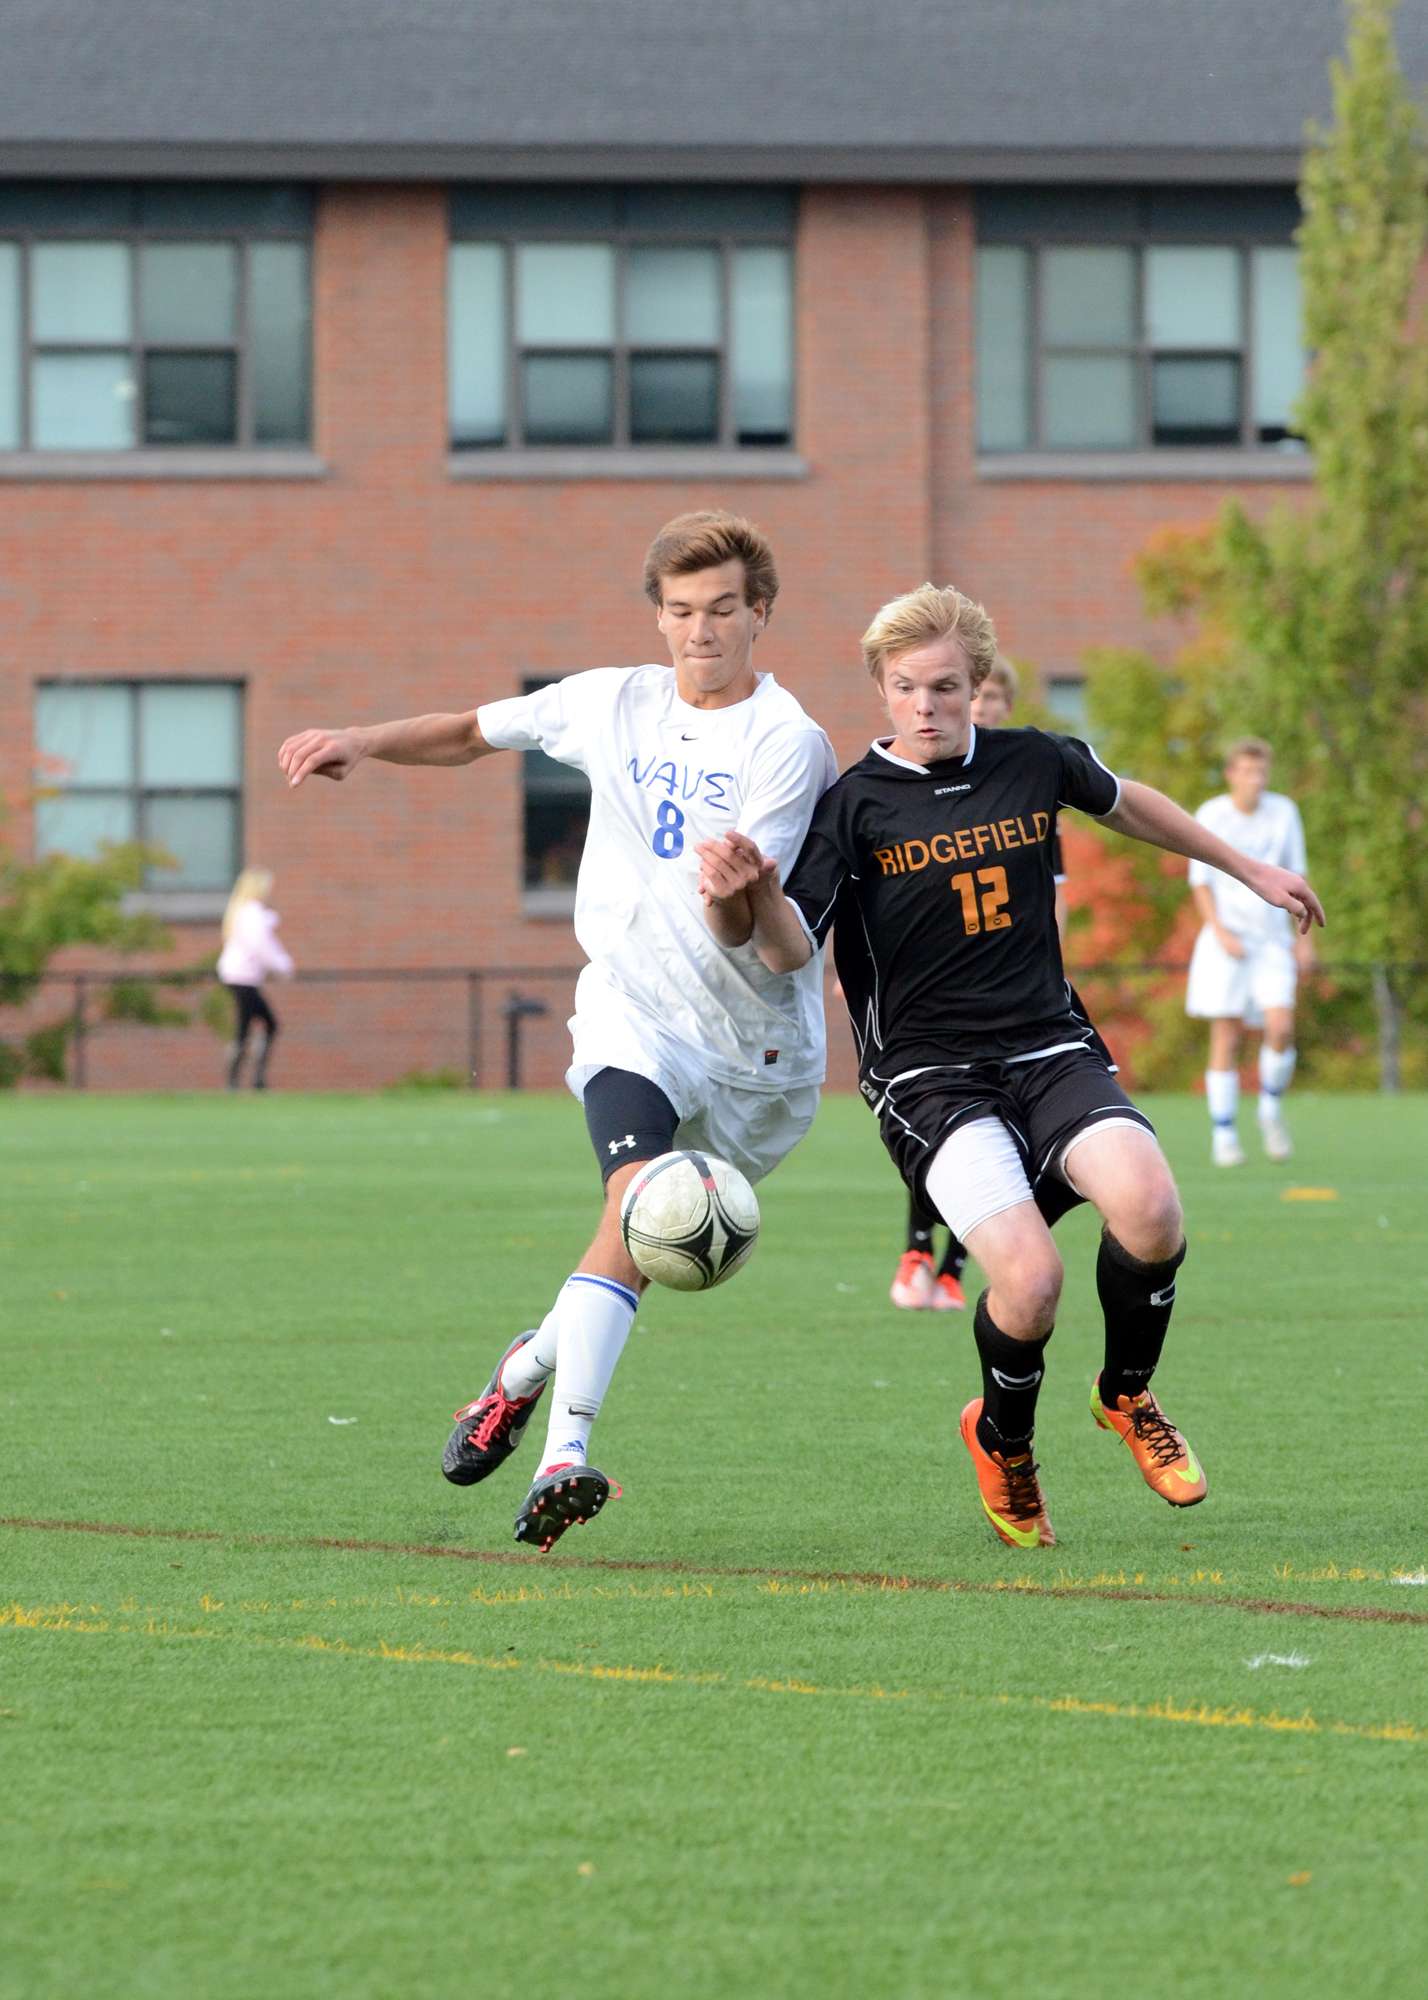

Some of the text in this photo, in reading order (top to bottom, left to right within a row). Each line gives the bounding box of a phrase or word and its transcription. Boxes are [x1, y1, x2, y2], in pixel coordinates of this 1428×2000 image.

[626, 754, 734, 811] WAVE
[934, 784, 971, 795] STANNO
[652, 799, 684, 859] 8
[874, 812, 1049, 875] RIDGEFIELD
[951, 865, 1012, 936] 12
